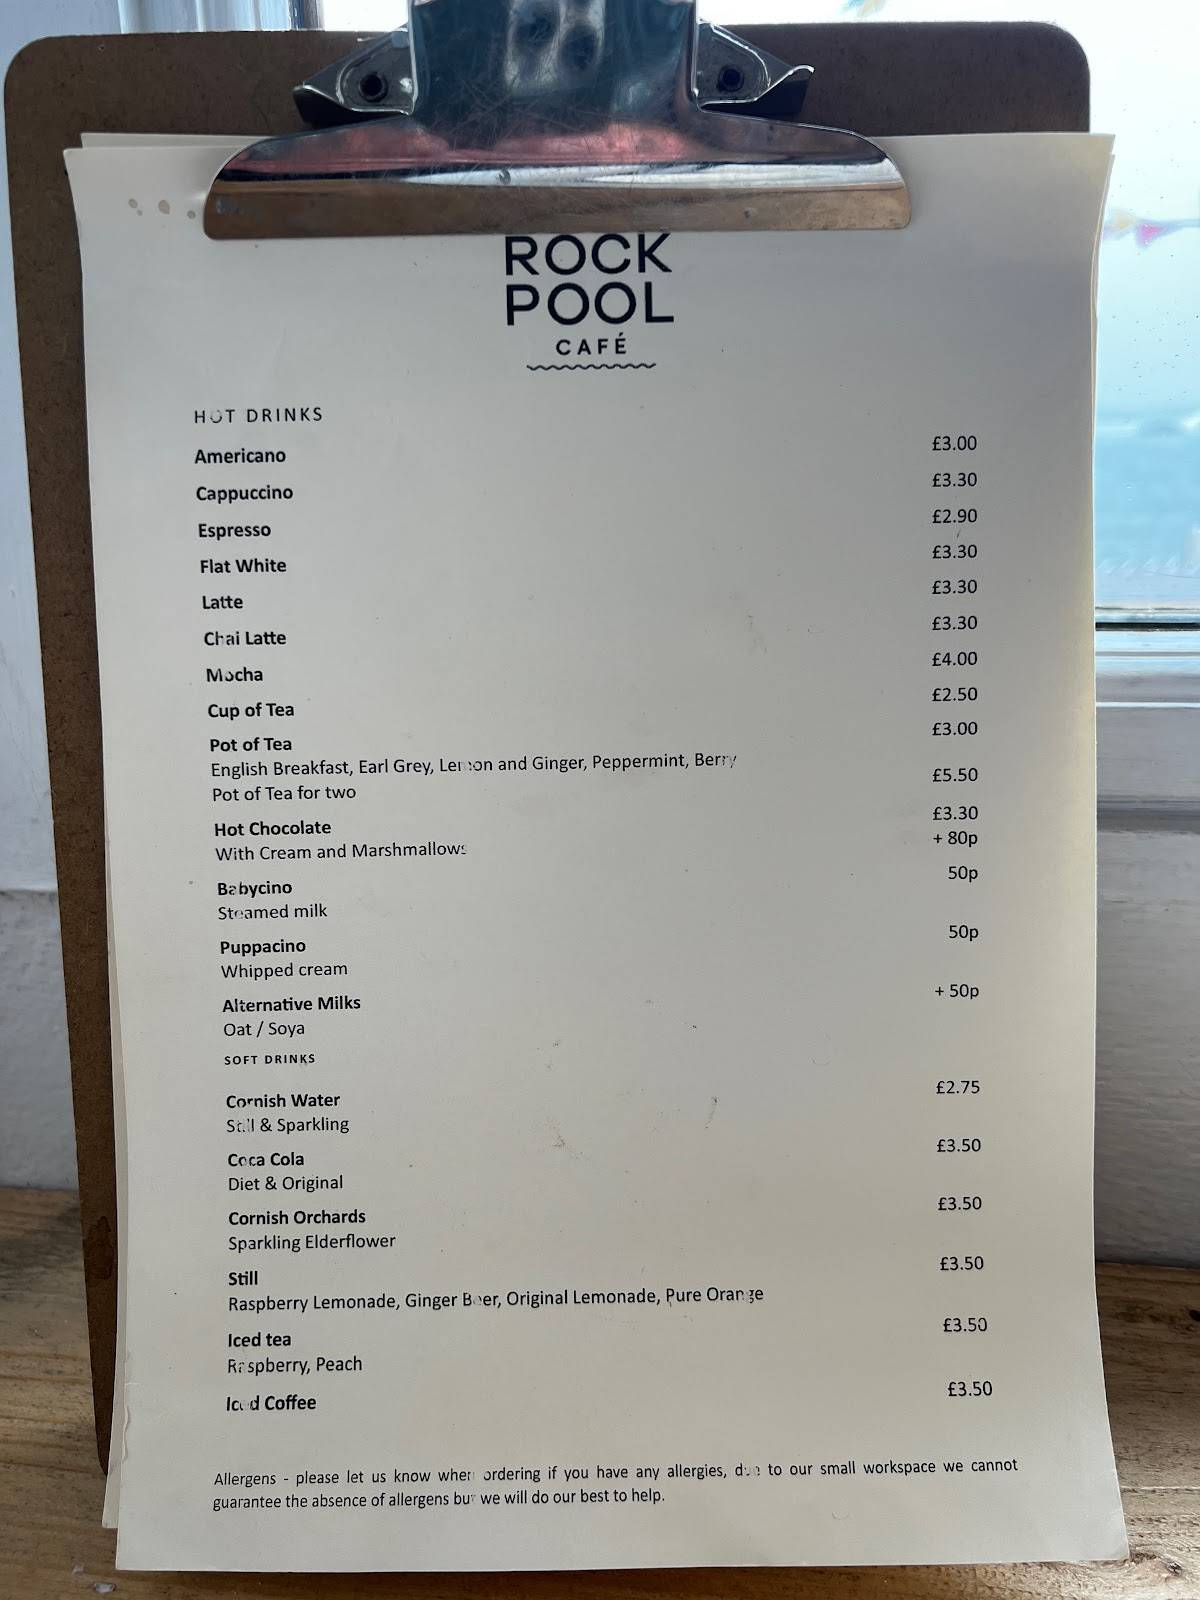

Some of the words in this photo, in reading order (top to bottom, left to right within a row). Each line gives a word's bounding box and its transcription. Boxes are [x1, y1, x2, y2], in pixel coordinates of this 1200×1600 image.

[505, 233, 673, 276] ROCK
[506, 281, 675, 326] POOL
[555, 332, 628, 356] CAFÉ
[194, 408, 236, 424] HOT
[246, 406, 323, 423] DRINKS
[931, 435, 978, 452] £3.00
[194, 447, 287, 465] Americano
[931, 471, 978, 488] £3.30
[195, 484, 294, 505] Cappuccino
[931, 508, 978, 524] £2.90
[197, 522, 272, 542] Espresso
[932, 543, 978, 560] £3.30
[199, 558, 232, 574] Flat
[234, 557, 287, 574] White
[931, 578, 978, 595] £3.30
[201, 594, 244, 610] Latte
[931, 615, 978, 631] £3.30
[203, 630, 241, 647] Chai
[244, 630, 287, 646] Latte
[931, 651, 978, 667] £4.00
[205, 666, 264, 683] Mocha
[931, 686, 978, 702] £2.50
[207, 703, 241, 721] Cup
[244, 701, 263, 718] of
[264, 702, 295, 717] Tea
[931, 721, 978, 737] £3.00
[209, 738, 239, 753] Pot
[242, 736, 261, 752] of
[262, 737, 293, 752] Tea
[211, 761, 268, 781] English
[273, 758, 354, 777] Breakfast,
[358, 758, 389, 774] Earl
[392, 758, 435, 777] Grey,
[497, 755, 528, 771] and
[532, 755, 588, 774] Ginger,
[592, 753, 689, 773] Peppermint,
[932, 767, 979, 783] £5.50
[212, 787, 240, 803] Pot
[243, 785, 262, 801] of
[264, 786, 293, 801] Tea
[296, 784, 321, 800] for
[324, 786, 357, 800] two
[932, 805, 979, 821] £3.30
[214, 822, 245, 837] Hot
[248, 819, 332, 837] Chocolate
[947, 830, 979, 848] 80p
[214, 845, 255, 862] With
[259, 846, 312, 861] Cream
[316, 843, 347, 859] and
[947, 865, 979, 884] 50p
[217, 880, 293, 899] Babycino
[217, 903, 289, 921] Steamed
[294, 902, 328, 918] milk
[948, 924, 979, 942] 50p
[220, 938, 307, 958] Puppacino
[220, 961, 294, 982] Whipped
[298, 964, 348, 977] cream
[949, 983, 980, 1000] 50p
[221, 996, 313, 1013] Alternative
[317, 994, 361, 1011] Milks
[223, 1022, 253, 1037] Oat
[255, 1020, 265, 1039] /
[268, 1021, 305, 1039] Soya
[224, 1055, 259, 1066] SOFT
[264, 1053, 316, 1065] DRINKS
[935, 1079, 981, 1095] £2.75
[225, 1093, 287, 1109] Cornish
[290, 1093, 341, 1108] Water
[259, 1117, 273, 1133] &
[276, 1116, 350, 1135] Sparkling
[936, 1138, 982, 1153] £3.50
[227, 1153, 266, 1168] Coca
[269, 1151, 305, 1167] Cola
[228, 1176, 261, 1191] Diet
[264, 1175, 278, 1191] &
[282, 1174, 343, 1194] Original
[937, 1195, 983, 1211] £3.50
[228, 1209, 289, 1226] Cornish
[293, 1208, 367, 1225] Orchards
[228, 1234, 302, 1254] Sparkling
[305, 1233, 397, 1249] Elderflower
[939, 1255, 985, 1272] £3.50
[228, 1270, 259, 1287] Still
[228, 1295, 309, 1315] Raspberry
[313, 1292, 401, 1311] Lemonade,
[405, 1292, 458, 1311] Ginger
[506, 1288, 569, 1309] Original
[573, 1287, 661, 1307] Lemonade,
[665, 1287, 702, 1304] Pure
[942, 1317, 988, 1333] £3.50
[228, 1331, 262, 1348] Iced
[265, 1332, 292, 1348] tea
[316, 1354, 363, 1372] Peach
[947, 1380, 993, 1398] £3.50
[264, 1393, 317, 1411] Coffee
[213, 1471, 277, 1489] Allergens
[296, 1469, 340, 1488] please
[346, 1469, 365, 1484] let
[371, 1472, 387, 1484] us
[393, 1468, 432, 1484] know
[483, 1466, 541, 1484] ordering
[548, 1465, 558, 1480] if
[563, 1468, 589, 1483] you
[596, 1464, 629, 1479] have
[635, 1467, 660, 1481] any
[667, 1463, 727, 1481] allergies,
[767, 1463, 783, 1477] to
[789, 1464, 814, 1477] our
[820, 1460, 856, 1476] small
[862, 1459, 936, 1477] workspace
[942, 1461, 964, 1473] we
[970, 1458, 1019, 1473] cannot
[212, 1495, 282, 1512] guarantee
[285, 1493, 308, 1508] the
[311, 1493, 367, 1508] absence
[370, 1492, 387, 1507] of
[388, 1491, 450, 1510] allergens
[480, 1493, 501, 1505] we
[504, 1489, 528, 1505] will
[531, 1489, 550, 1505] do
[552, 1492, 577, 1504] our
[580, 1488, 610, 1504] best
[612, 1489, 628, 1503] to
[631, 1487, 665, 1505] help.
